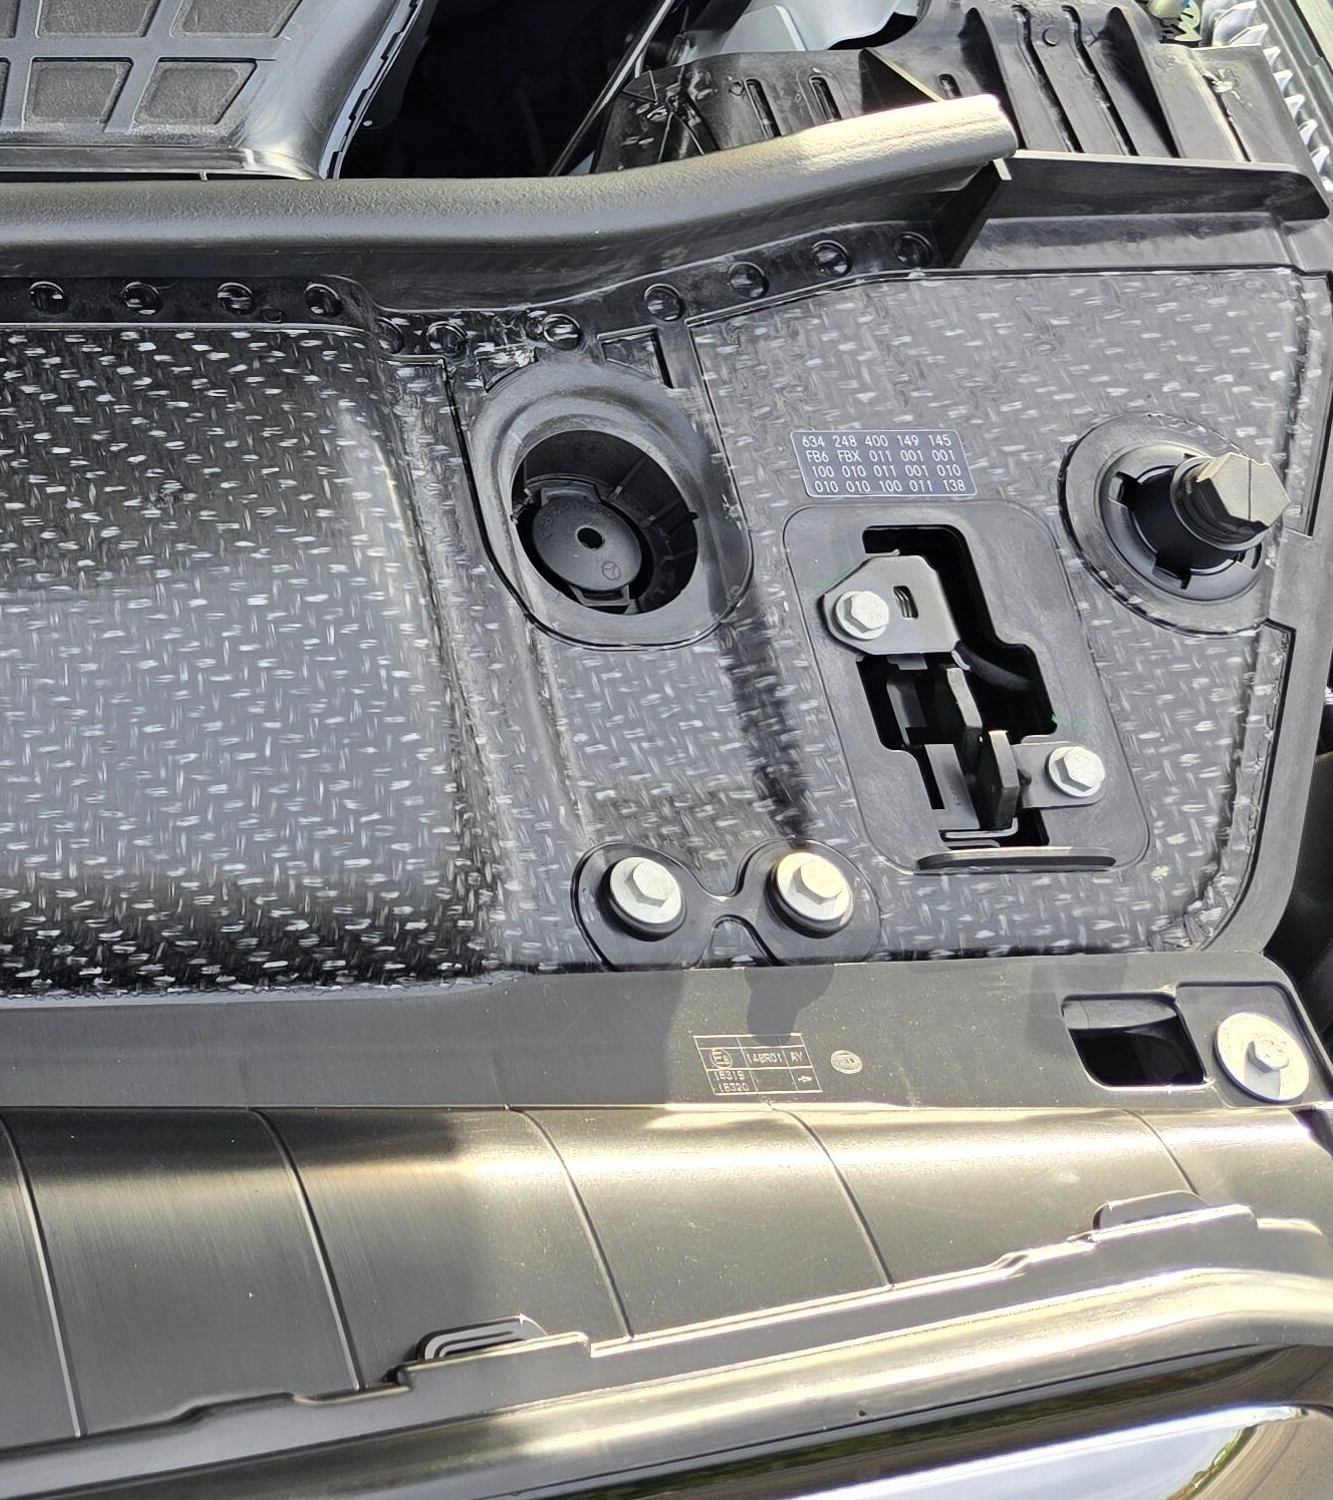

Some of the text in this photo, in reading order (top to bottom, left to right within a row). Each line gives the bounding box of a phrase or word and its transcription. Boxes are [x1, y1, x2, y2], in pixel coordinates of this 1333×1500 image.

[803, 435, 951, 448] 634 248 400 149 145
[806, 450, 956, 463] FB6 FBX 011 001 001
[811, 465, 961, 478] 100 010 011 001 010
[814, 480, 965, 493] 010 010 100 011 138
